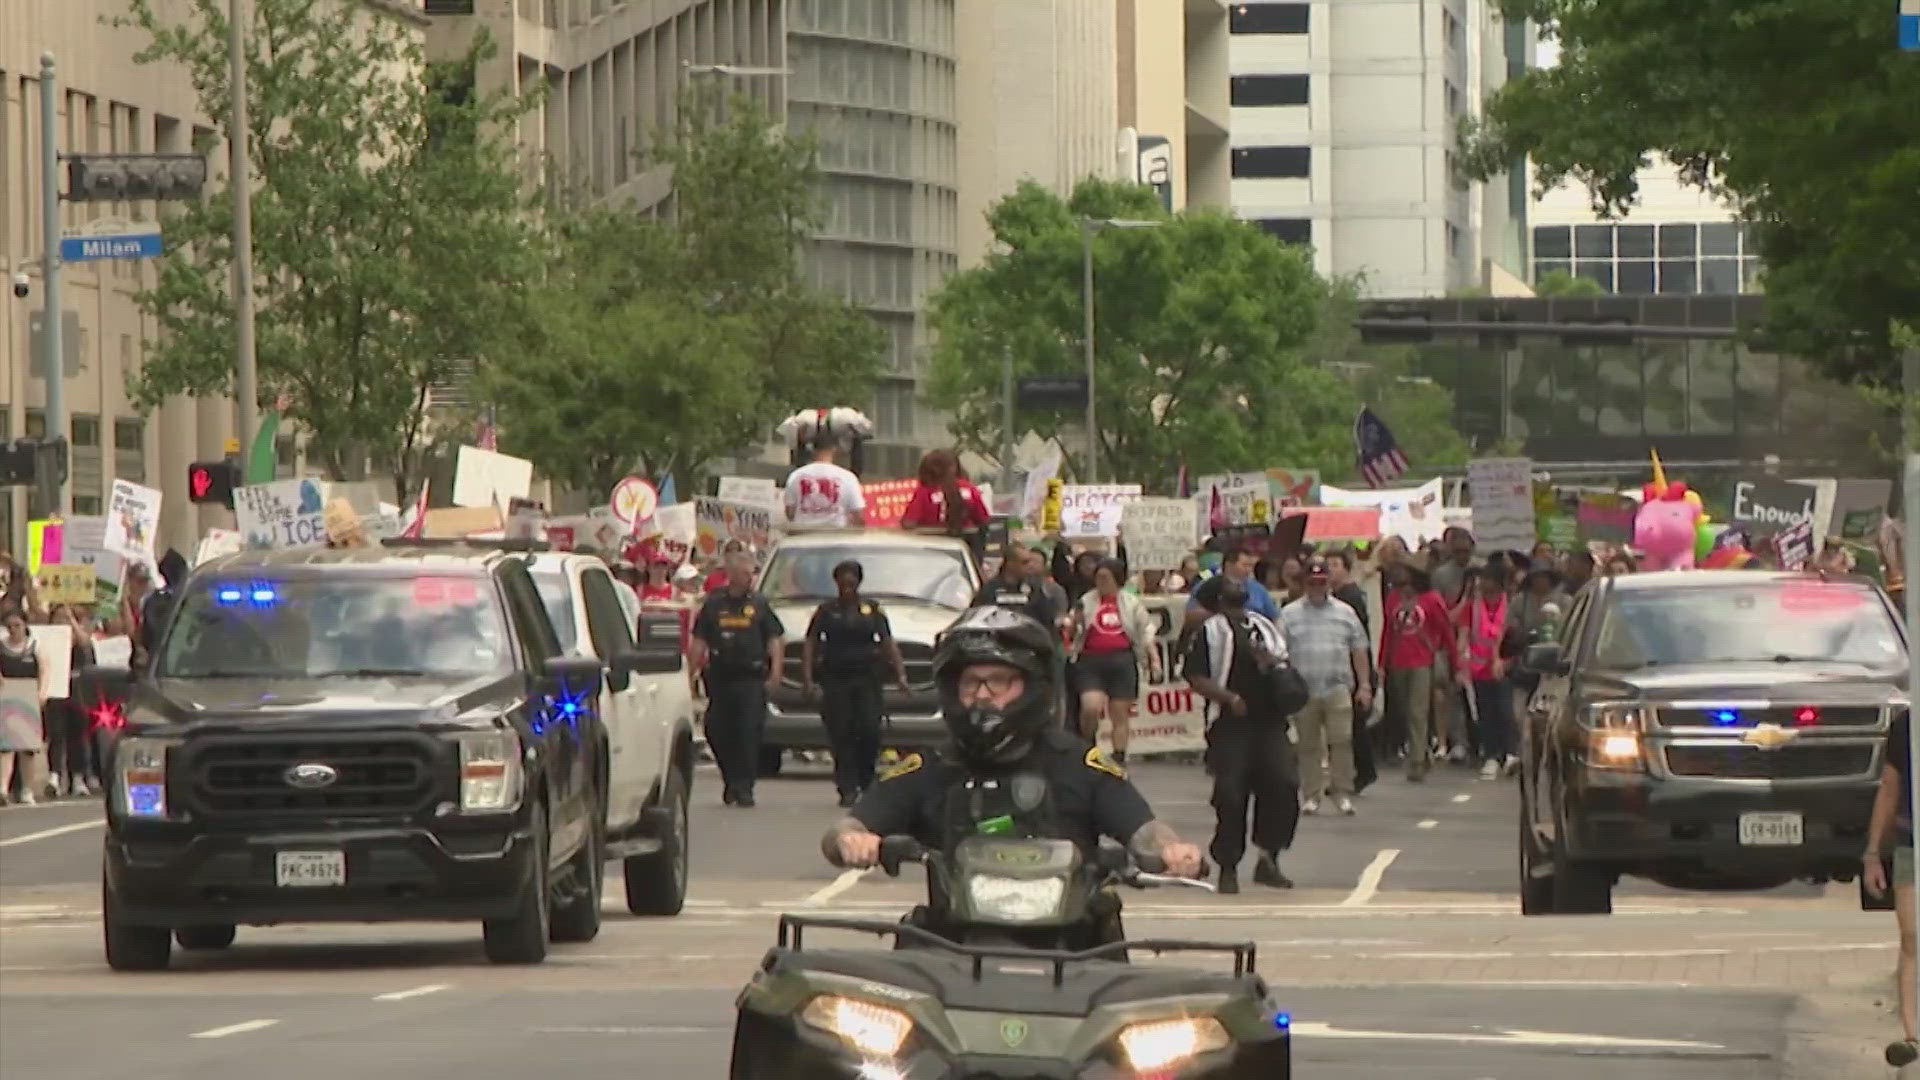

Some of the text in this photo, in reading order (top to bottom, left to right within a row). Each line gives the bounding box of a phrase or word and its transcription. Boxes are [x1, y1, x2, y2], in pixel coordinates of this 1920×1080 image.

[82, 241, 142, 256] Milam
[282, 515, 325, 546] ICE
[1147, 690, 1193, 715] OUT
